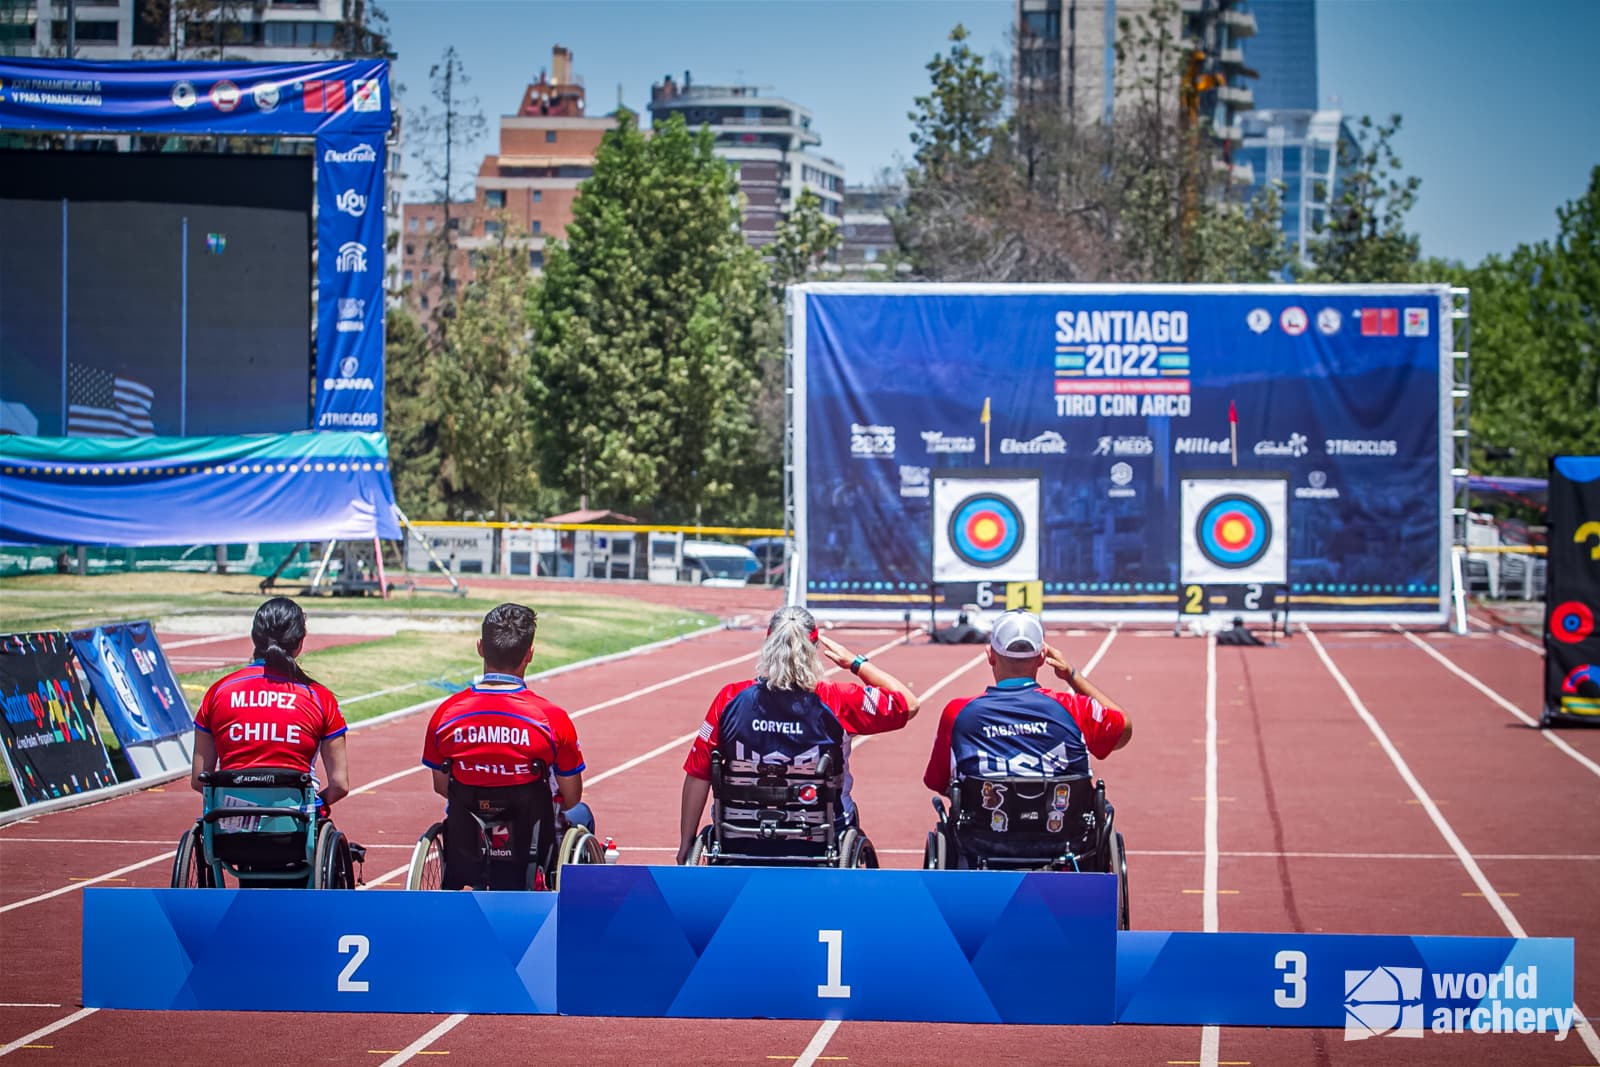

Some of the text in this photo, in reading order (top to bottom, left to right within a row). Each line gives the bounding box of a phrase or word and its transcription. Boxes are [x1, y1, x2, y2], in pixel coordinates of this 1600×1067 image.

[1055, 310, 1188, 343] SANTIAGO
[1085, 344, 1158, 377] 2022
[1055, 394, 1191, 417] TIRO CON ARCO
[977, 582, 994, 607] 6
[1018, 585, 1032, 610] 1
[1185, 584, 1203, 613] 2
[231, 691, 297, 710] M.LOPEZ
[229, 722, 302, 744] CHILE
[454, 726, 530, 747] B.GAMBOA
[752, 719, 803, 735] CORYELL
[983, 722, 1048, 738] TABANSKY
[977, 742, 1069, 777] USA
[481, 848, 512, 857] Tleton
[337, 935, 370, 992] 2
[817, 930, 851, 998] 1
[1274, 950, 1307, 1009] 3
